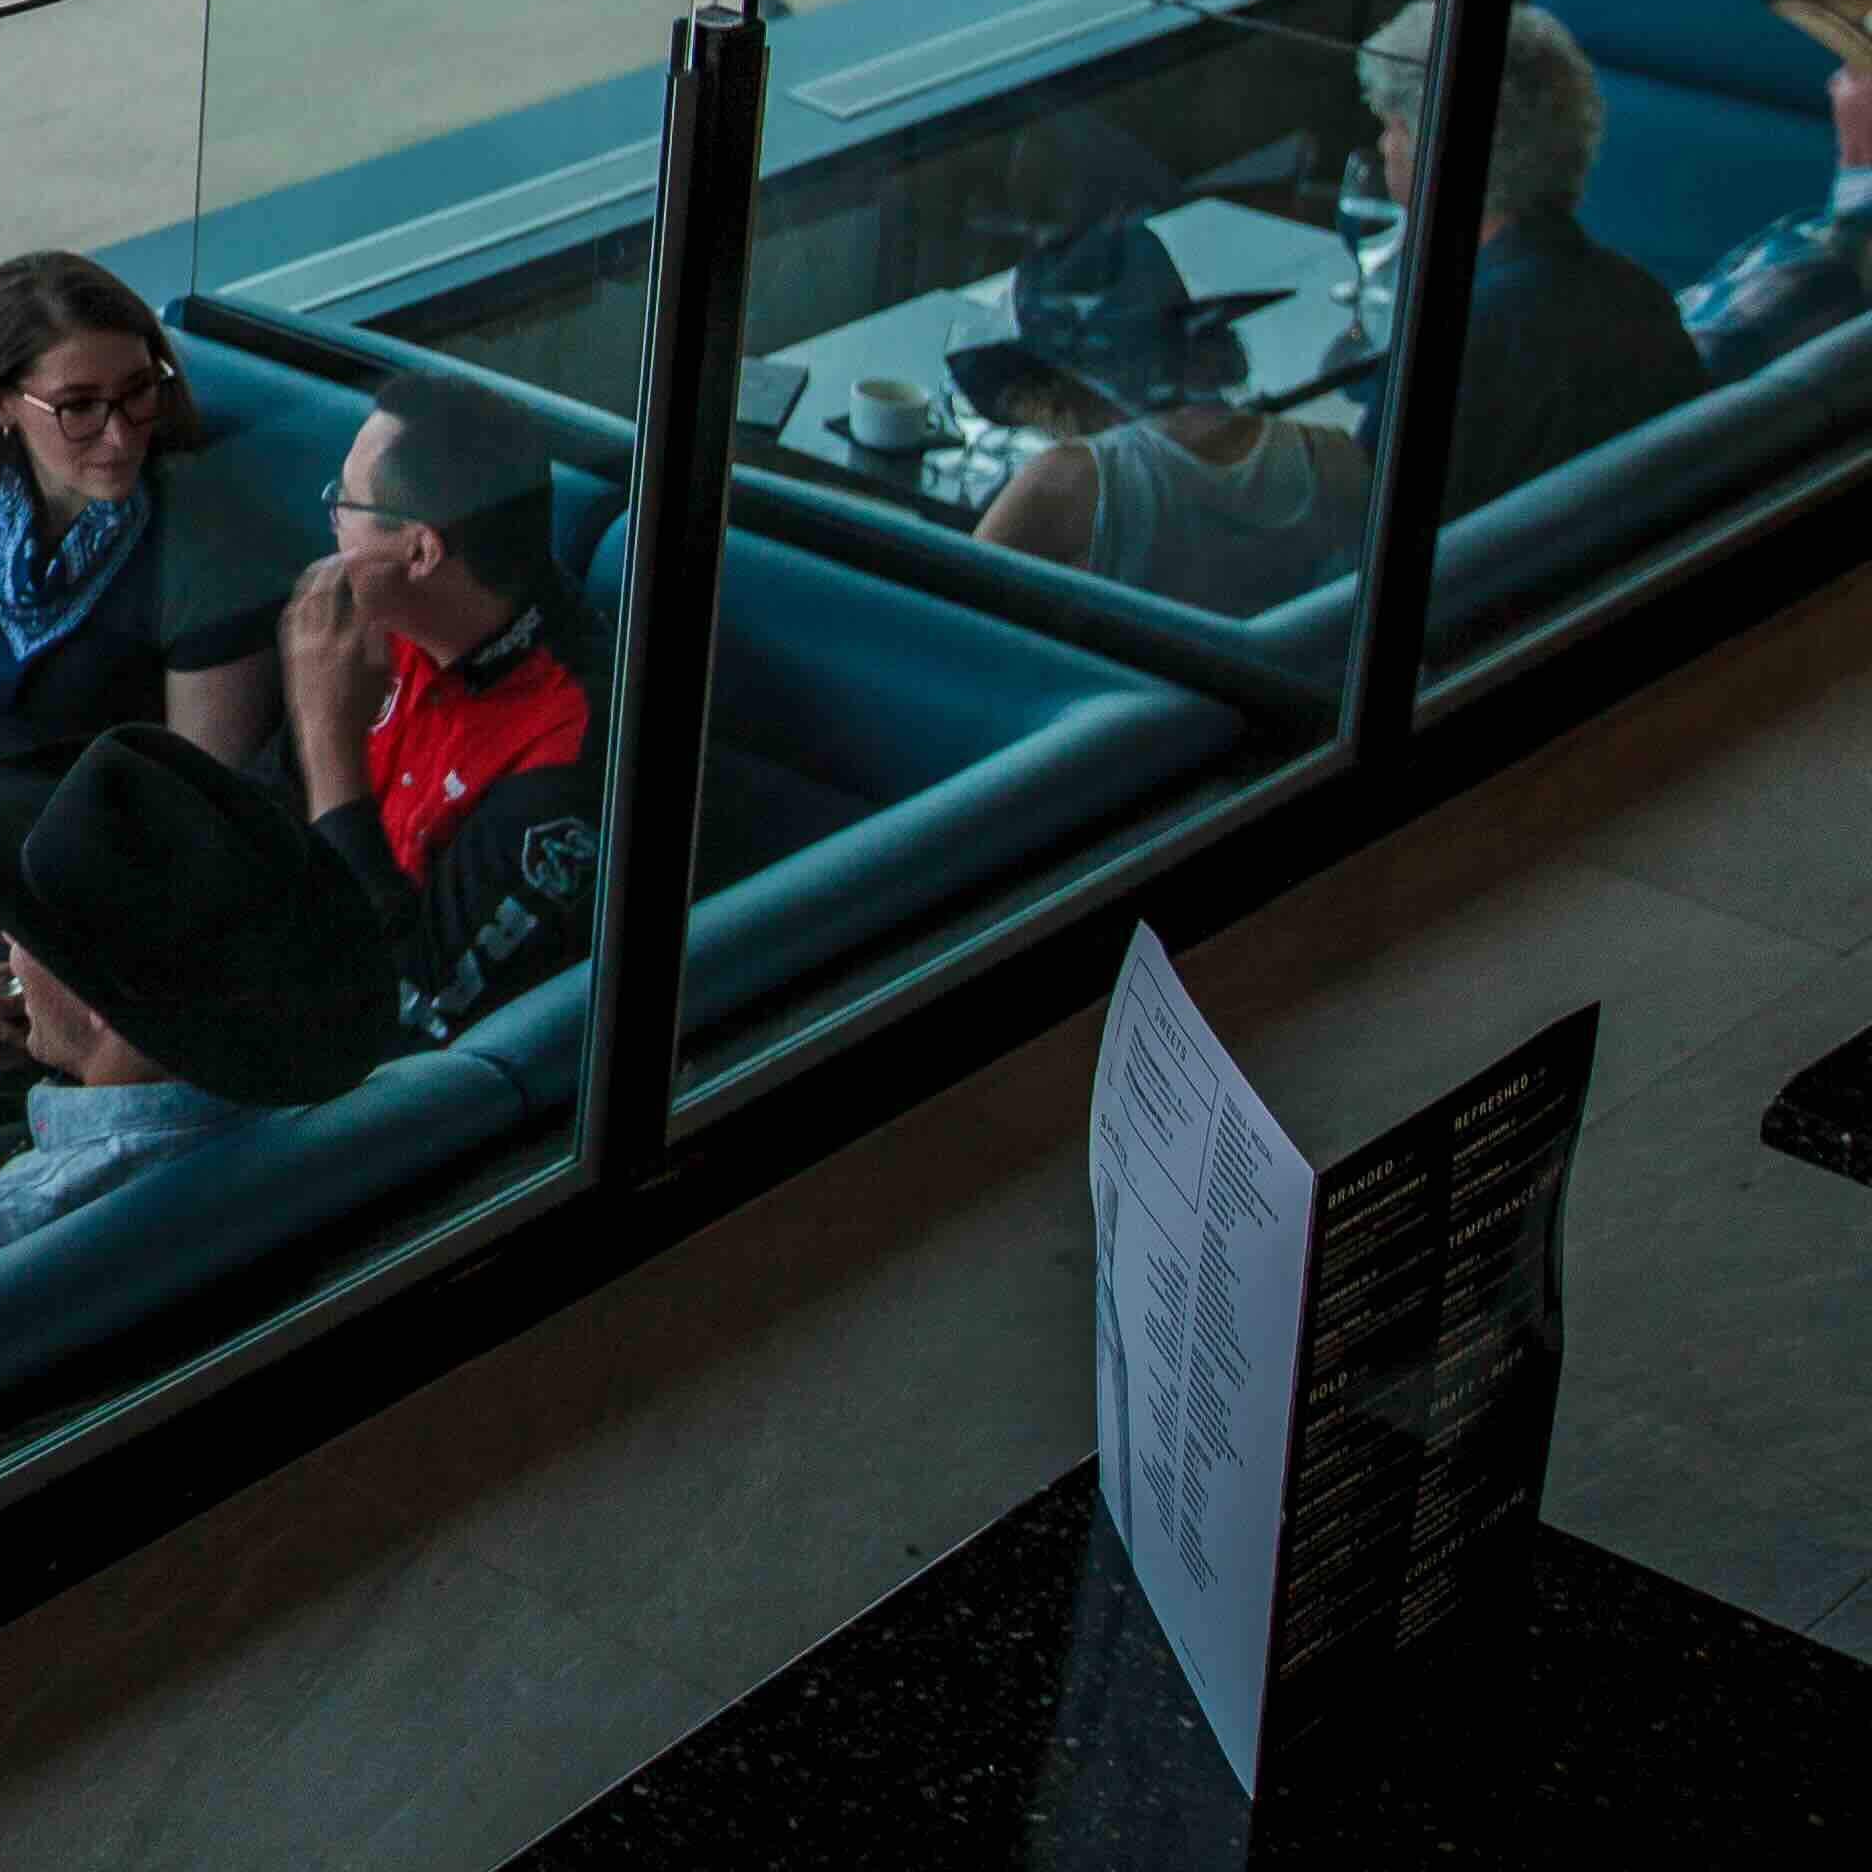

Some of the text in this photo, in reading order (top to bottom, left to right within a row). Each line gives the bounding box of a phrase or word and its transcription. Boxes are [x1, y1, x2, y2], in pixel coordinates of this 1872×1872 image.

[1152, 1005, 1189, 1065] SWEETS
[1452, 1071, 1531, 1134] REFRESHED
[1326, 1158, 1395, 1212] BRANDED
[1447, 1188, 1537, 1250] TEMPERANCE
[1308, 1370, 1349, 1405] BOLD
[1404, 1533, 1466, 1586] COOLERS
